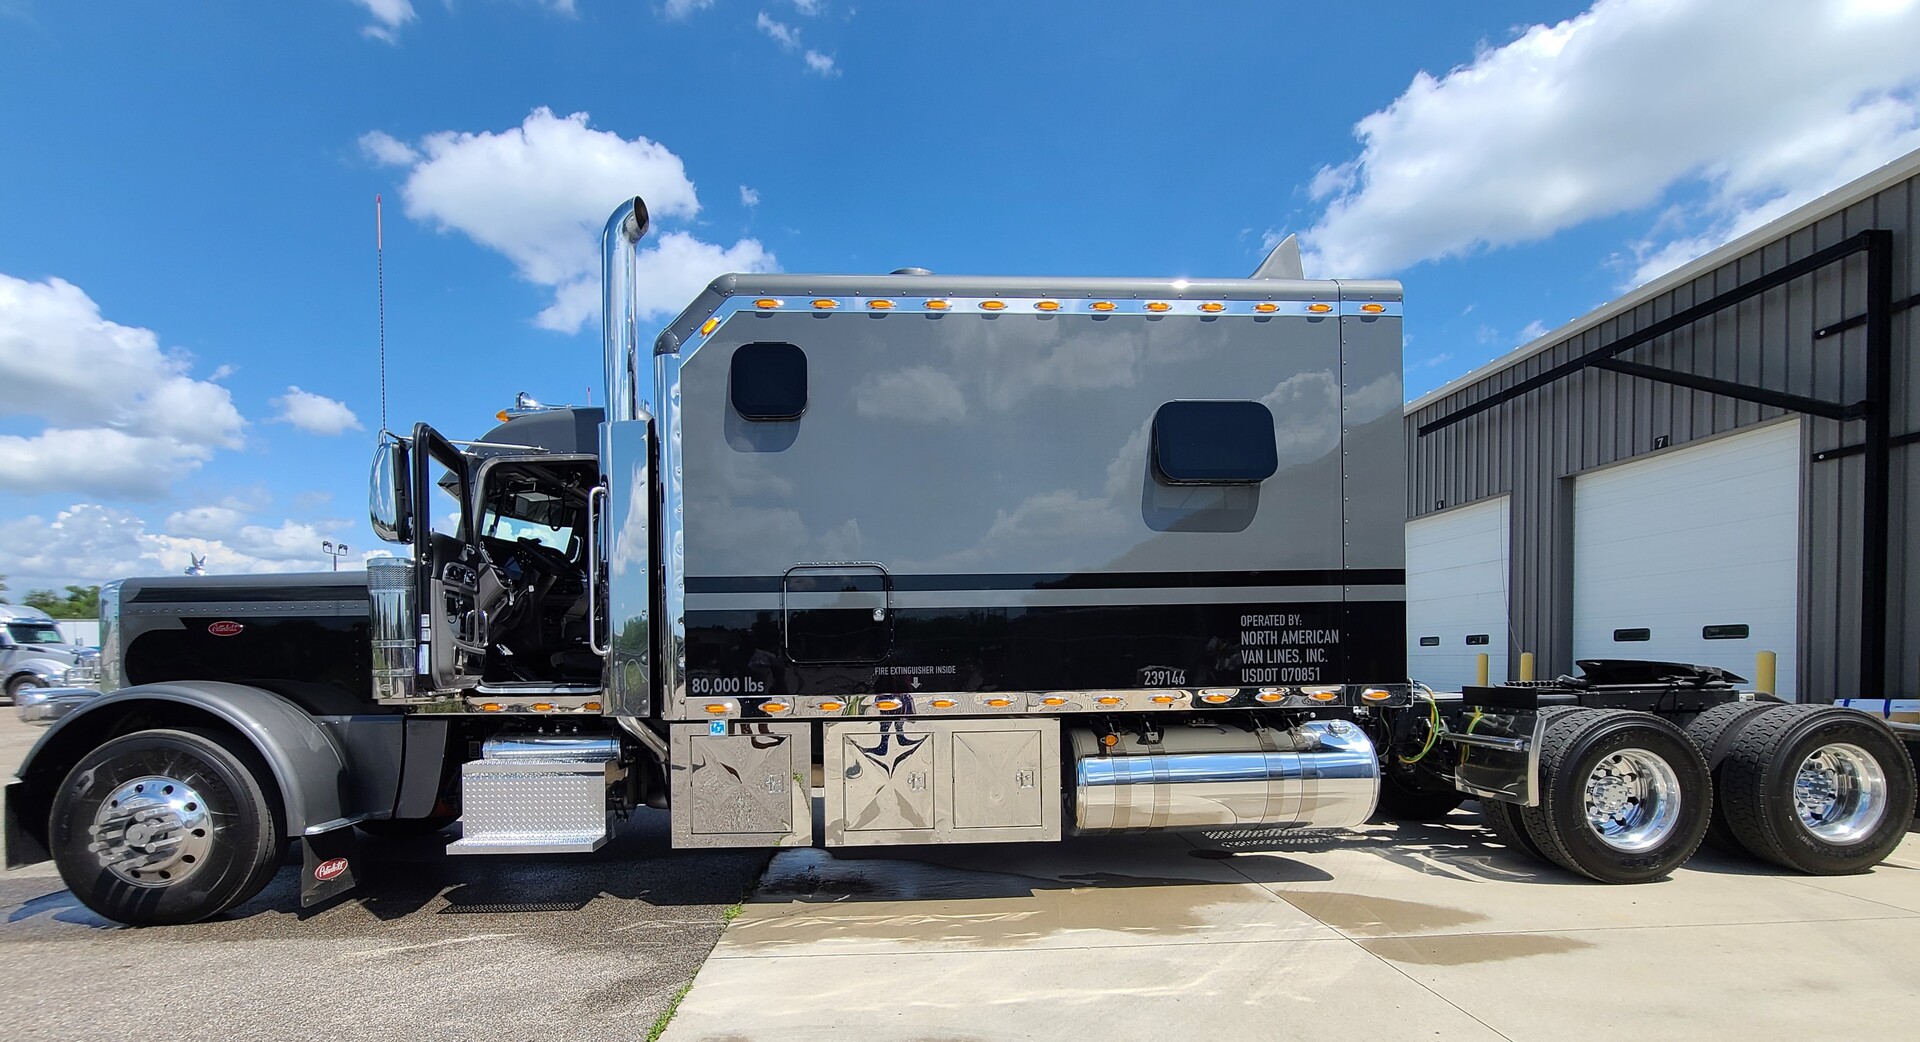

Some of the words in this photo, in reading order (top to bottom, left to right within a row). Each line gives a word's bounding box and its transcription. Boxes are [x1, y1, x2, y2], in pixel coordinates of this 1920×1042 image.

[1657, 437, 1664, 448] 7
[1240, 614, 1286, 627] OPERATED
[1288, 613, 1303, 626] BY:
[1241, 630, 1278, 646] NORTH
[1281, 629, 1340, 645] AMERICAN
[1241, 649, 1264, 665] VAN
[1266, 648, 1302, 664] LINES,
[1306, 647, 1328, 663] INC.
[874, 666, 889, 675] FIRE
[890, 665, 934, 675] EXTINGUISHER
[935, 665, 956, 674] INSIDE
[1144, 670, 1186, 686] 239146
[1241, 668, 1278, 683] USDOT
[1281, 667, 1321, 682] 070851
[692, 677, 740, 695] 80,000
[744, 676, 765, 692] lbs
